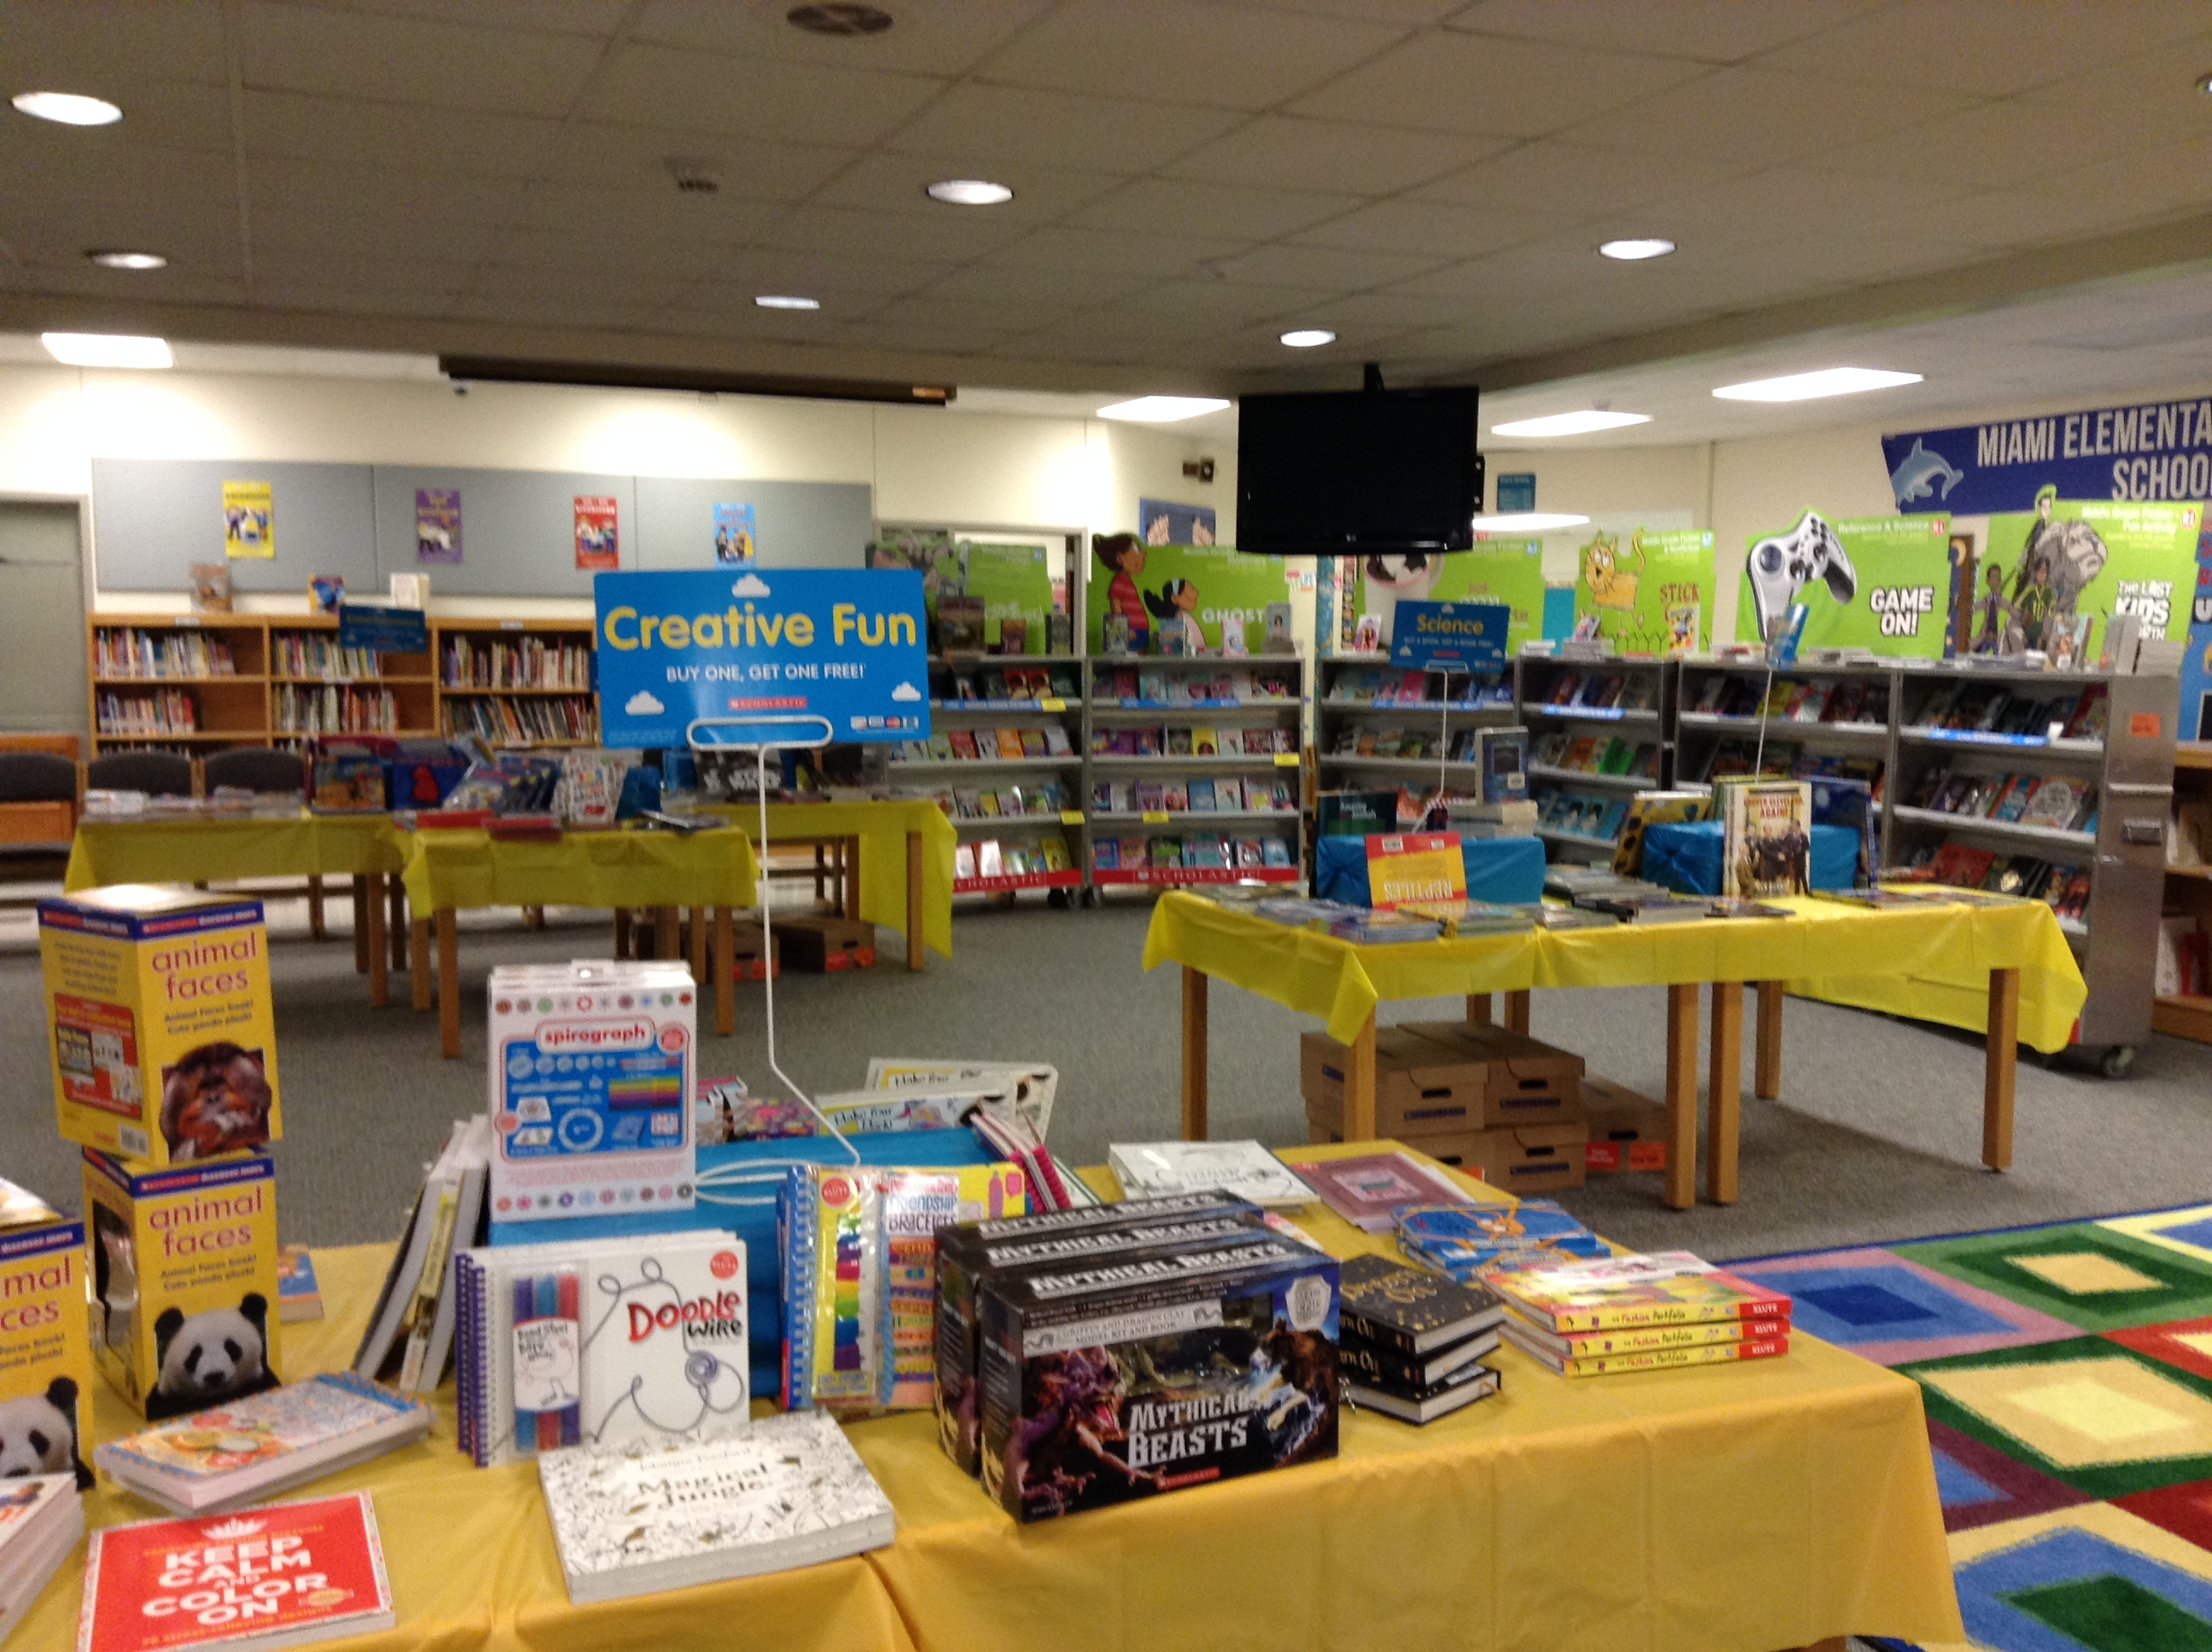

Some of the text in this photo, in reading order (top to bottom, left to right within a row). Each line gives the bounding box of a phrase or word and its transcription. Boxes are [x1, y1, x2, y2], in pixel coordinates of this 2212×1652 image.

[1977, 398, 2212, 467] MIAMI ELEMENTA
[2112, 452, 2212, 501] SCHOO
[1660, 583, 1700, 602] STICK
[1870, 585, 1934, 614] GAME
[2115, 595, 2171, 626] KIDS
[603, 602, 917, 651] Creative Fun
[1417, 613, 1484, 635] Science
[1880, 612, 1919, 637] ON!
[666, 662, 865, 683] BUY ONE, GET ONE FREE!
[955, 875, 1045, 890] CHOLASTIC
[152, 930, 258, 973] animal
[166, 969, 249, 1003] faces
[544, 1024, 646, 1045] spirograph
[148, 1184, 263, 1230] animal
[979, 1191, 1220, 1238] MYTHICAL BEASTS
[164, 1223, 253, 1259] faces
[987, 1216, 1240, 1266] MYTHICAL BEASTS
[0, 1253, 73, 1300] mal
[1027, 1242, 1289, 1300] MYTHICAL BEASTS
[0, 1299, 61, 1332] ces
[1128, 1388, 1256, 1436] MYTHICAL
[1127, 1417, 1250, 1469] BEASTS
[637, 1462, 768, 1495] Magical
[657, 1480, 765, 1511] Jungle
[158, 1550, 311, 1588] CALM
[166, 1535, 304, 1571] KEEP
[142, 1573, 329, 1617] COLOR
[197, 1597, 279, 1626] ON
